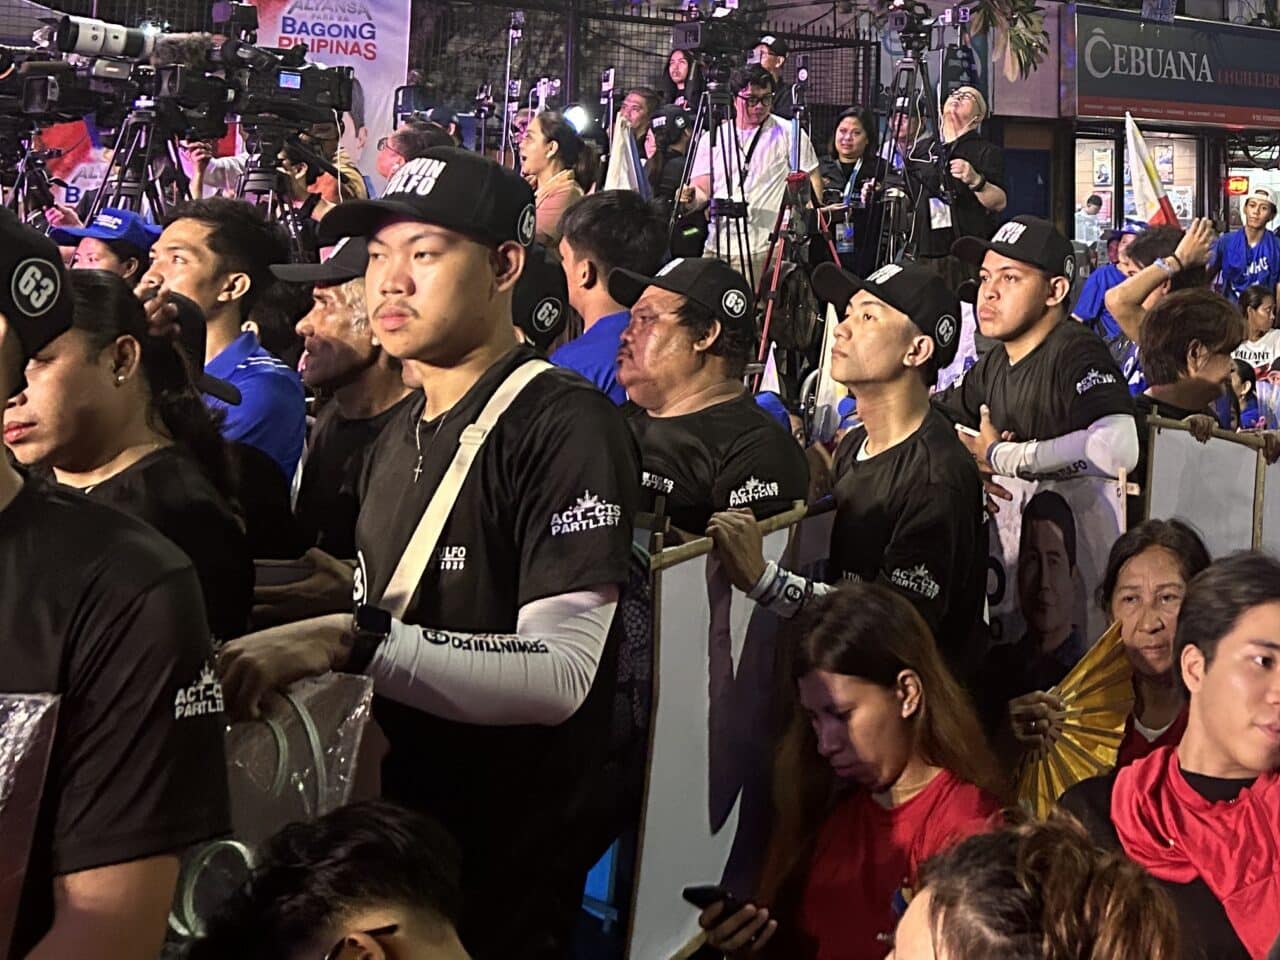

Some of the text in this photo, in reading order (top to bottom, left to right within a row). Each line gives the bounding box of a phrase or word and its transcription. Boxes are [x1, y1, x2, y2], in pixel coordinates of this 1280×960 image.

[282, 16, 376, 40] BAGONG
[1084, 27, 1214, 84] CEBUANA
[19, 265, 55, 309] 63
[537, 302, 559, 327] 63
[726, 292, 744, 314] 63
[938, 321, 954, 343] 63
[551, 504, 622, 526] ACT-CIS
[787, 586, 802, 600] 63
